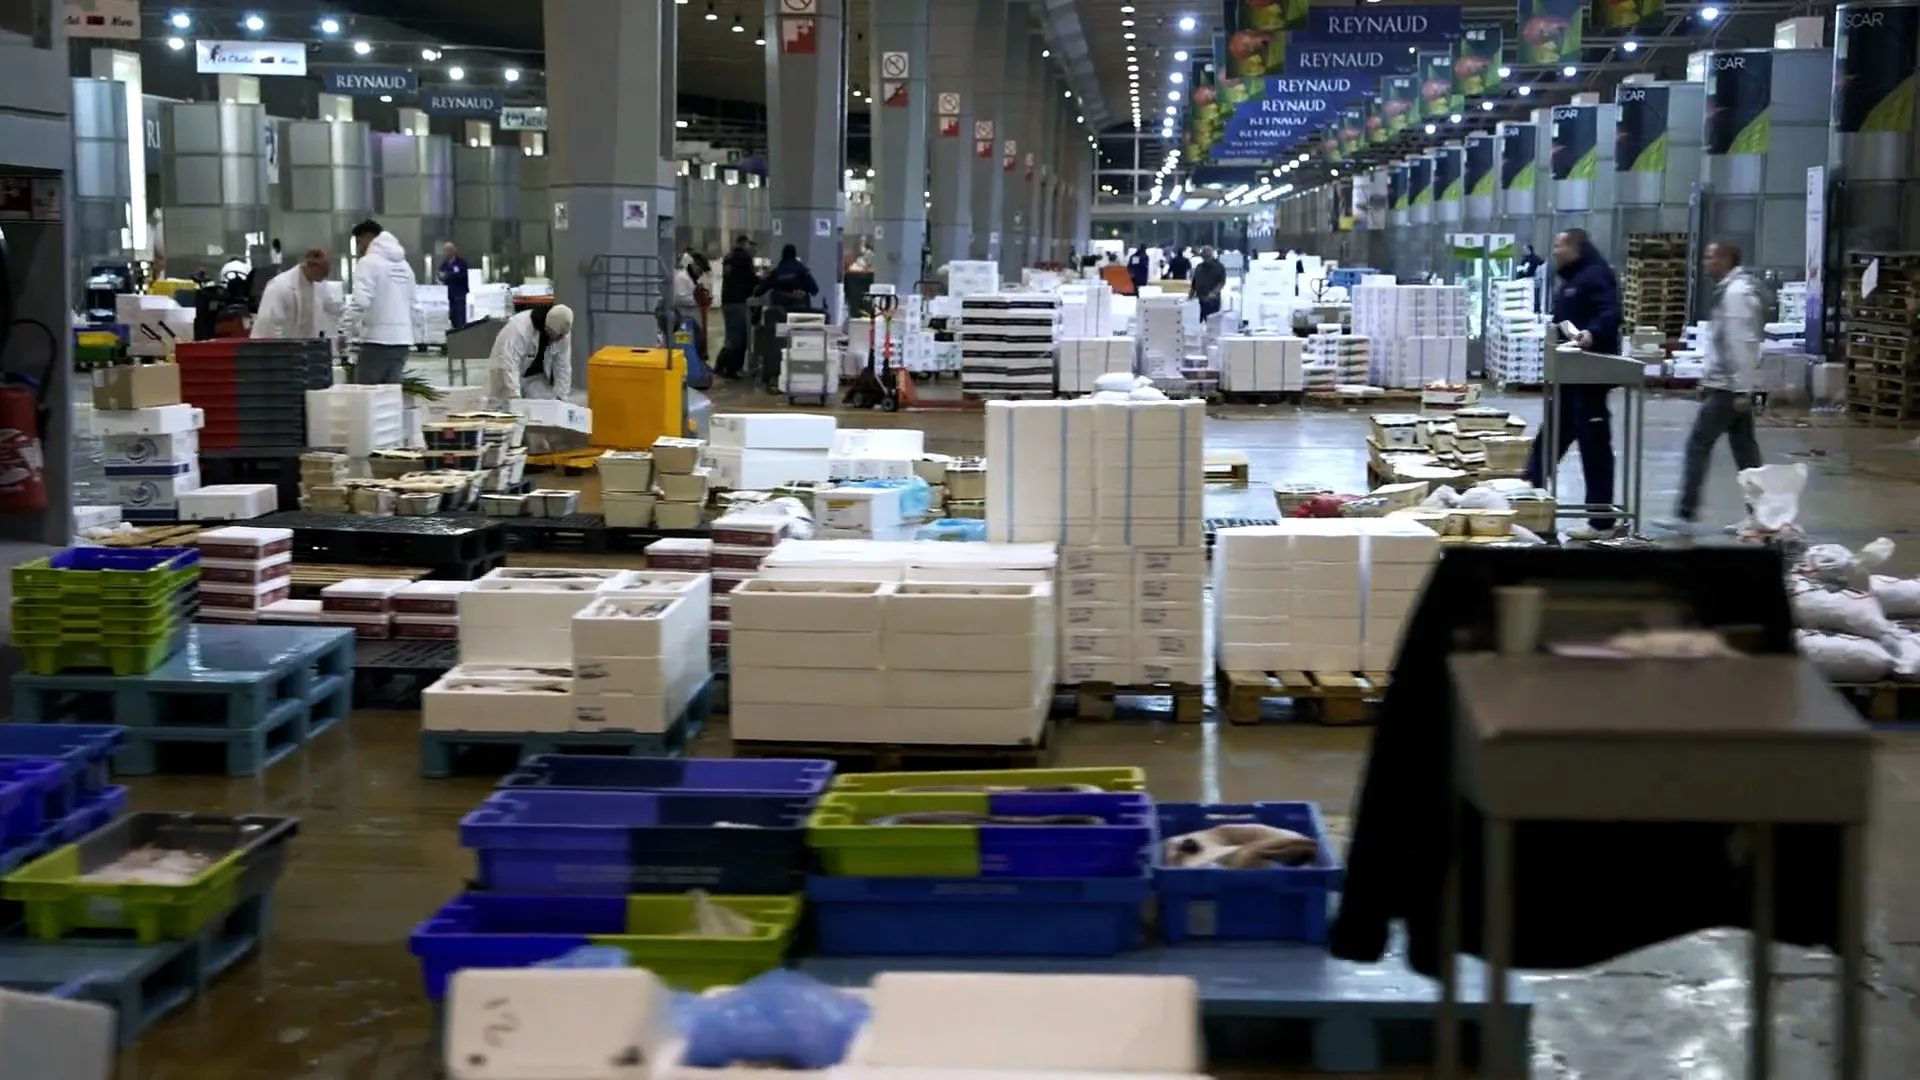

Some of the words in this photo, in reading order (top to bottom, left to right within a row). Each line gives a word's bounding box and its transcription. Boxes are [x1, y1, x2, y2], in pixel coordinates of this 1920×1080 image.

[1328, 15, 1428, 34] REYNAUD
[1300, 52, 1384, 68] REYNAUD
[336, 74, 406, 89] REYNAUD
[1278, 78, 1351, 93] REYNAUD
[431, 96, 494, 110] REYNAUD
[1261, 99, 1326, 112] REYNAUD
